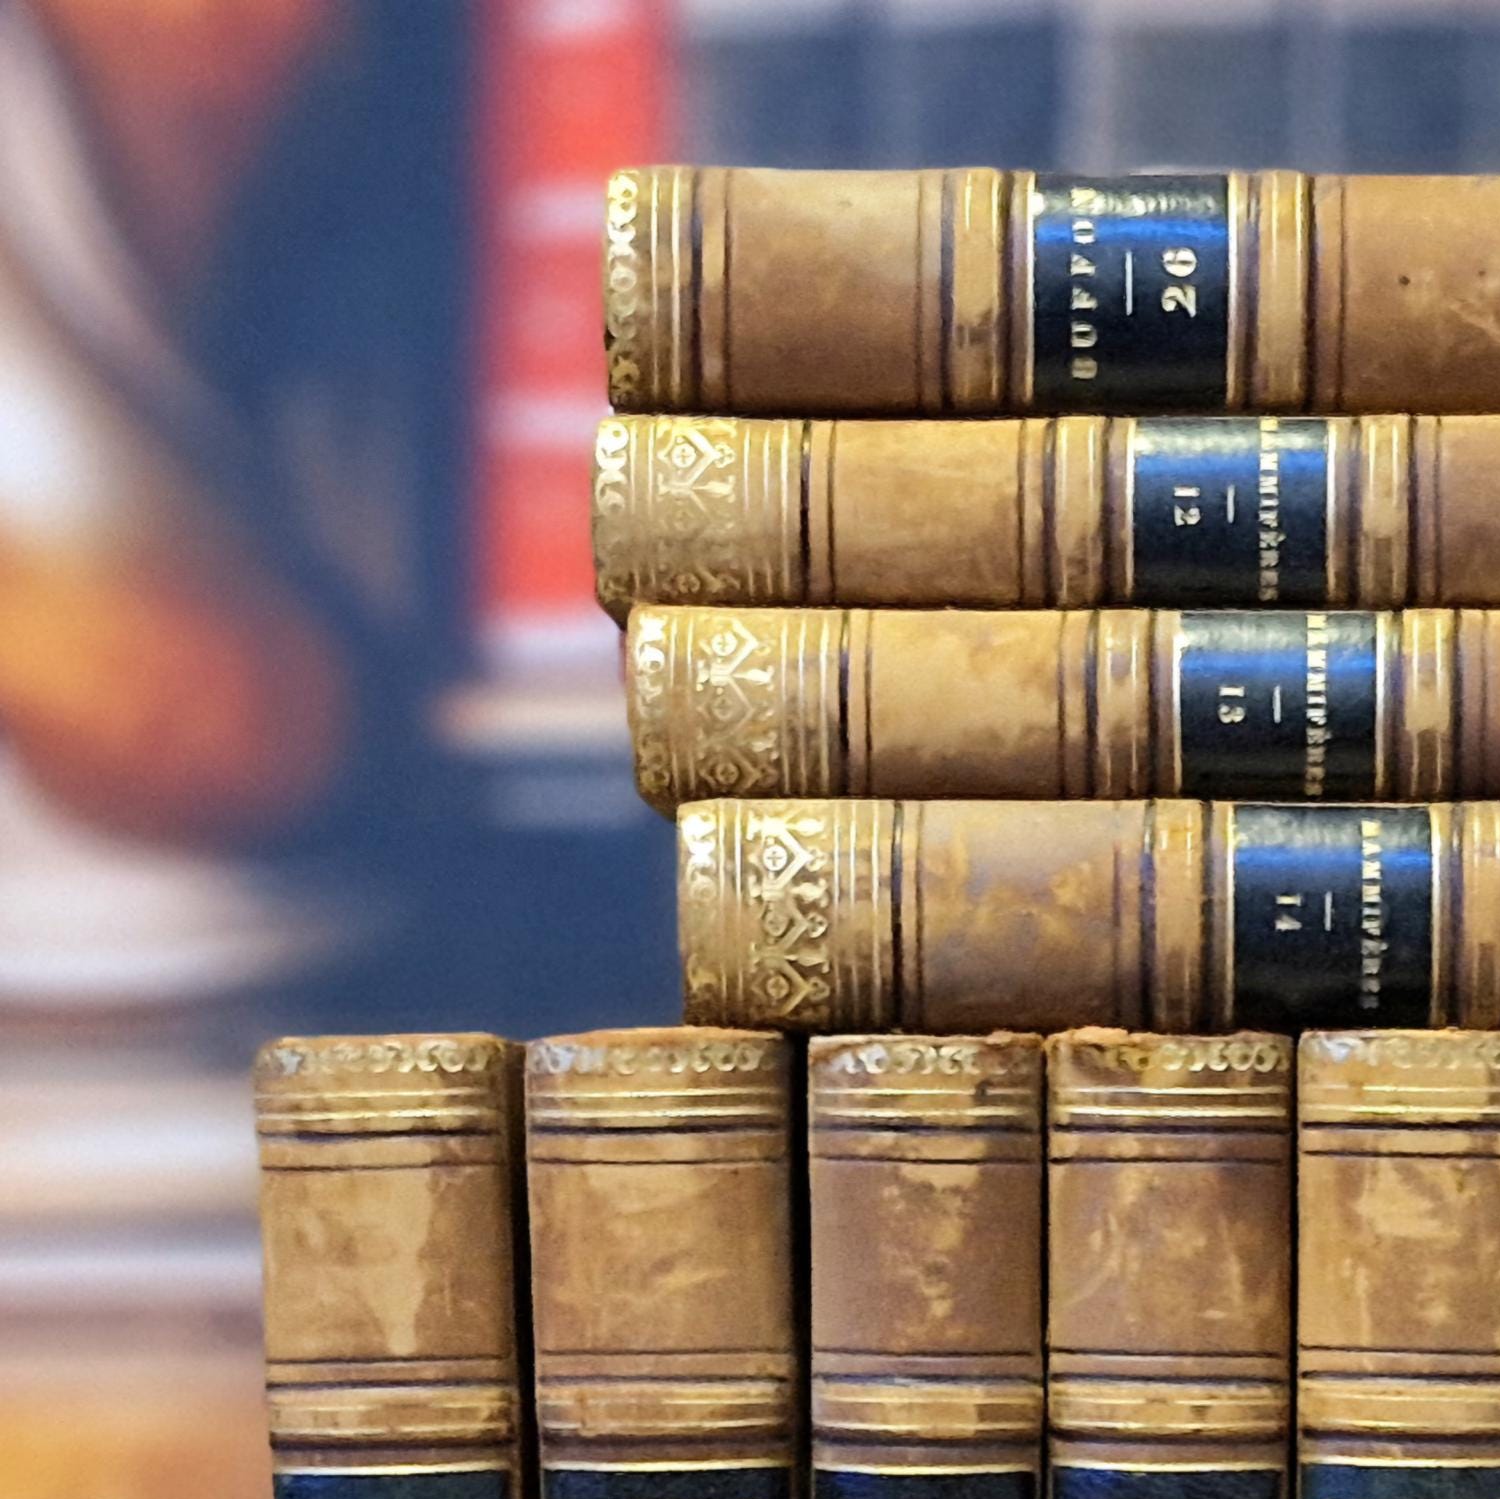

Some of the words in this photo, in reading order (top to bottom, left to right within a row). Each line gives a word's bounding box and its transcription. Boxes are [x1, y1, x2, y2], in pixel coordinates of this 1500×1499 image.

[1070, 187, 1098, 379] BUFFON
[1161, 248, 1197, 318] 26
[1174, 486, 1201, 527] 12
[1218, 686, 1246, 724] 13
